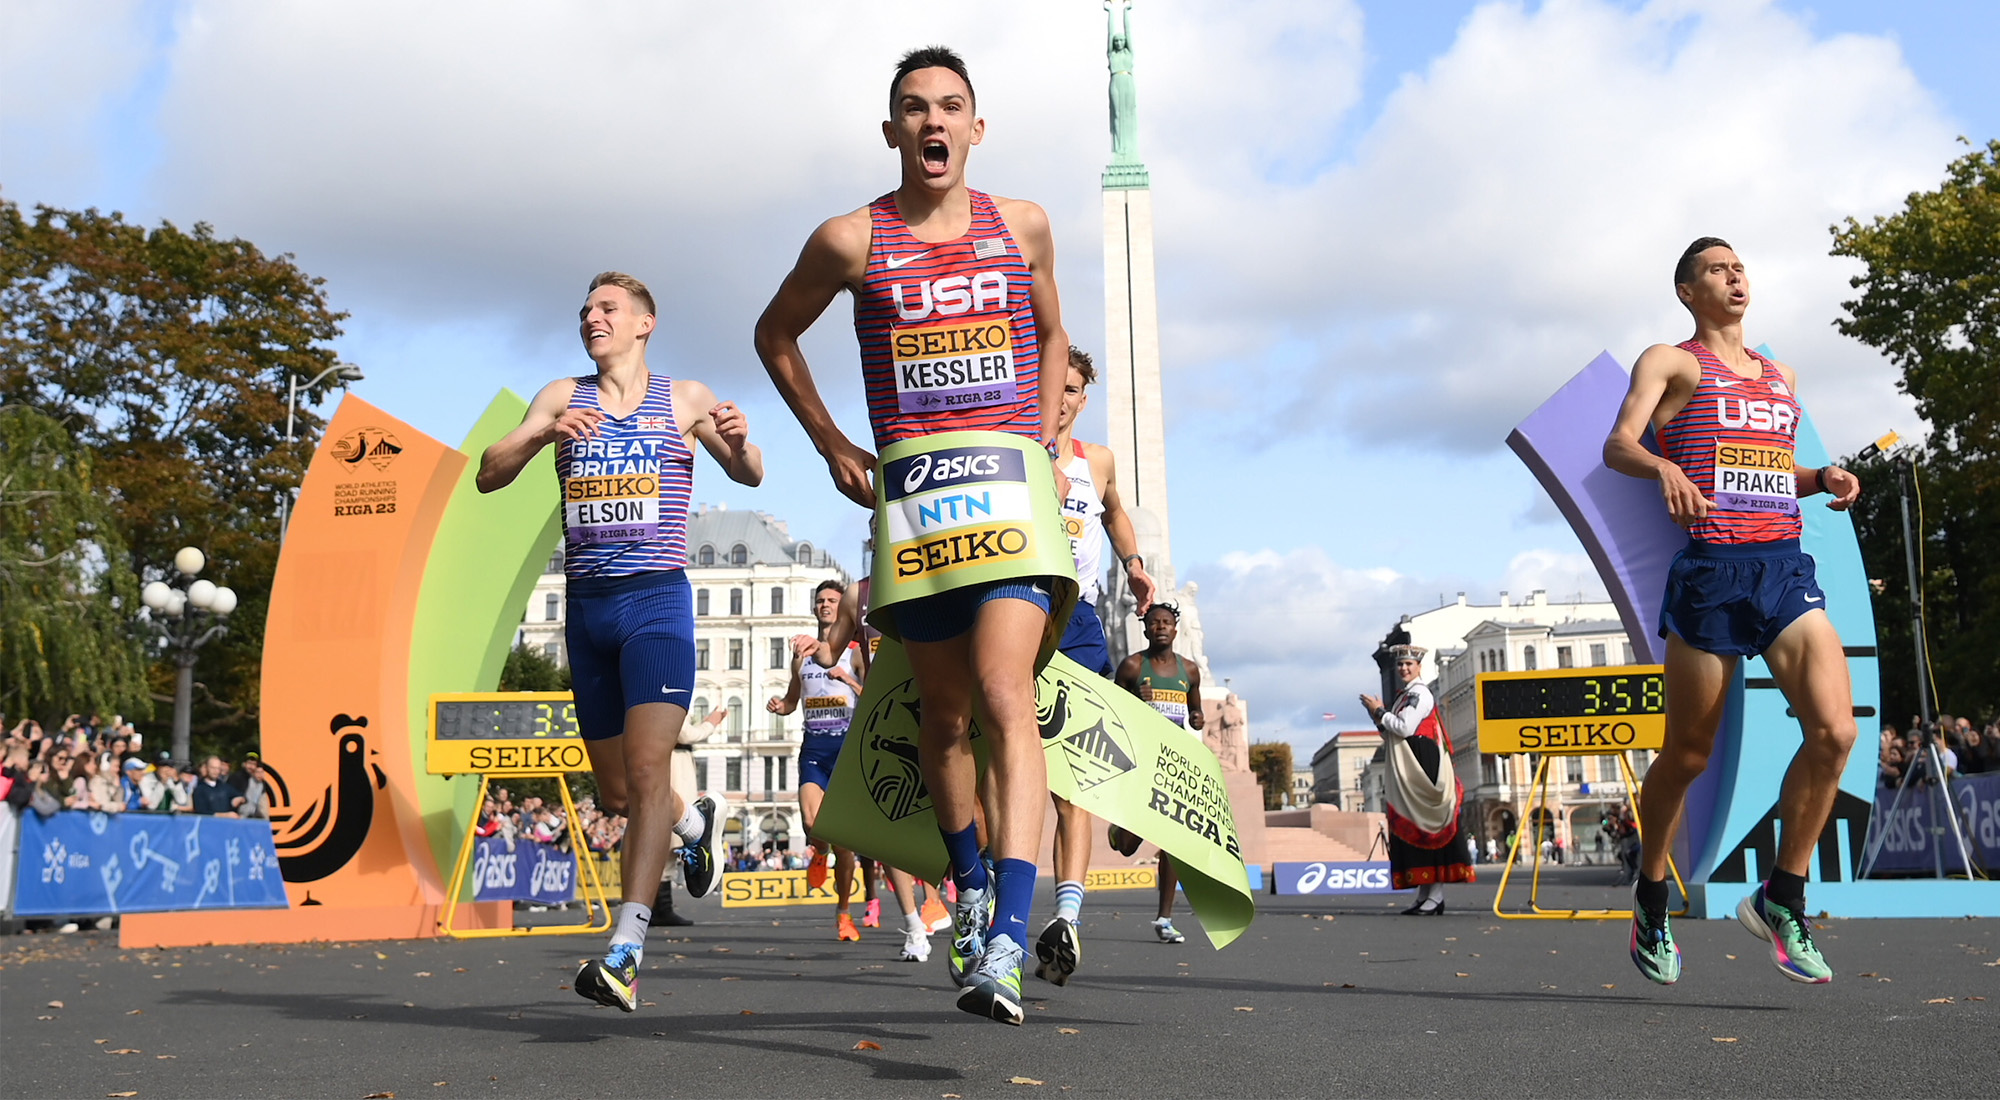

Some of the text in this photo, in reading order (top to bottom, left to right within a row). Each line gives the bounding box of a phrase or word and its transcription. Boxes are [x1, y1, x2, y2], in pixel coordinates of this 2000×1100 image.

[892, 271, 1008, 320] USA
[895, 325, 1006, 357] SEIKO
[902, 355, 1008, 389] KESSLER
[945, 390, 1001, 405] RIGA 23
[1717, 397, 1794, 434] USA
[571, 440, 664, 459] GREAT
[1719, 447, 1792, 471] SEIKO
[570, 459, 661, 478] BRITAIN
[932, 455, 1000, 482] asics
[335, 487, 397, 497] ROAD RUNNING
[568, 477, 655, 500] SEIKO
[1722, 471, 1792, 496] PRAKEL
[334, 495, 397, 505] CHAMPIONSHIPS
[335, 503, 396, 516] RIGA 23
[918, 491, 992, 529] NTN
[1750, 499, 1789, 510] RIGA 23
[578, 501, 643, 524] ELSON
[600, 528, 645, 539] RIGA 23
[896, 528, 1027, 577] SEIKO
[805, 697, 846, 709] SEIKO
[1153, 691, 1186, 703] EIKO
[805, 708, 846, 720] CAMPION
[1149, 702, 1186, 716] PHAHLELE
[1518, 722, 1636, 748] SEIKO
[470, 745, 584, 769] SEIKO
[1160, 742, 1202, 778] WORLD
[1156, 755, 1198, 790] ROAD
[1148, 786, 1241, 862] RIGA 2
[1326, 868, 1389, 889] asics
